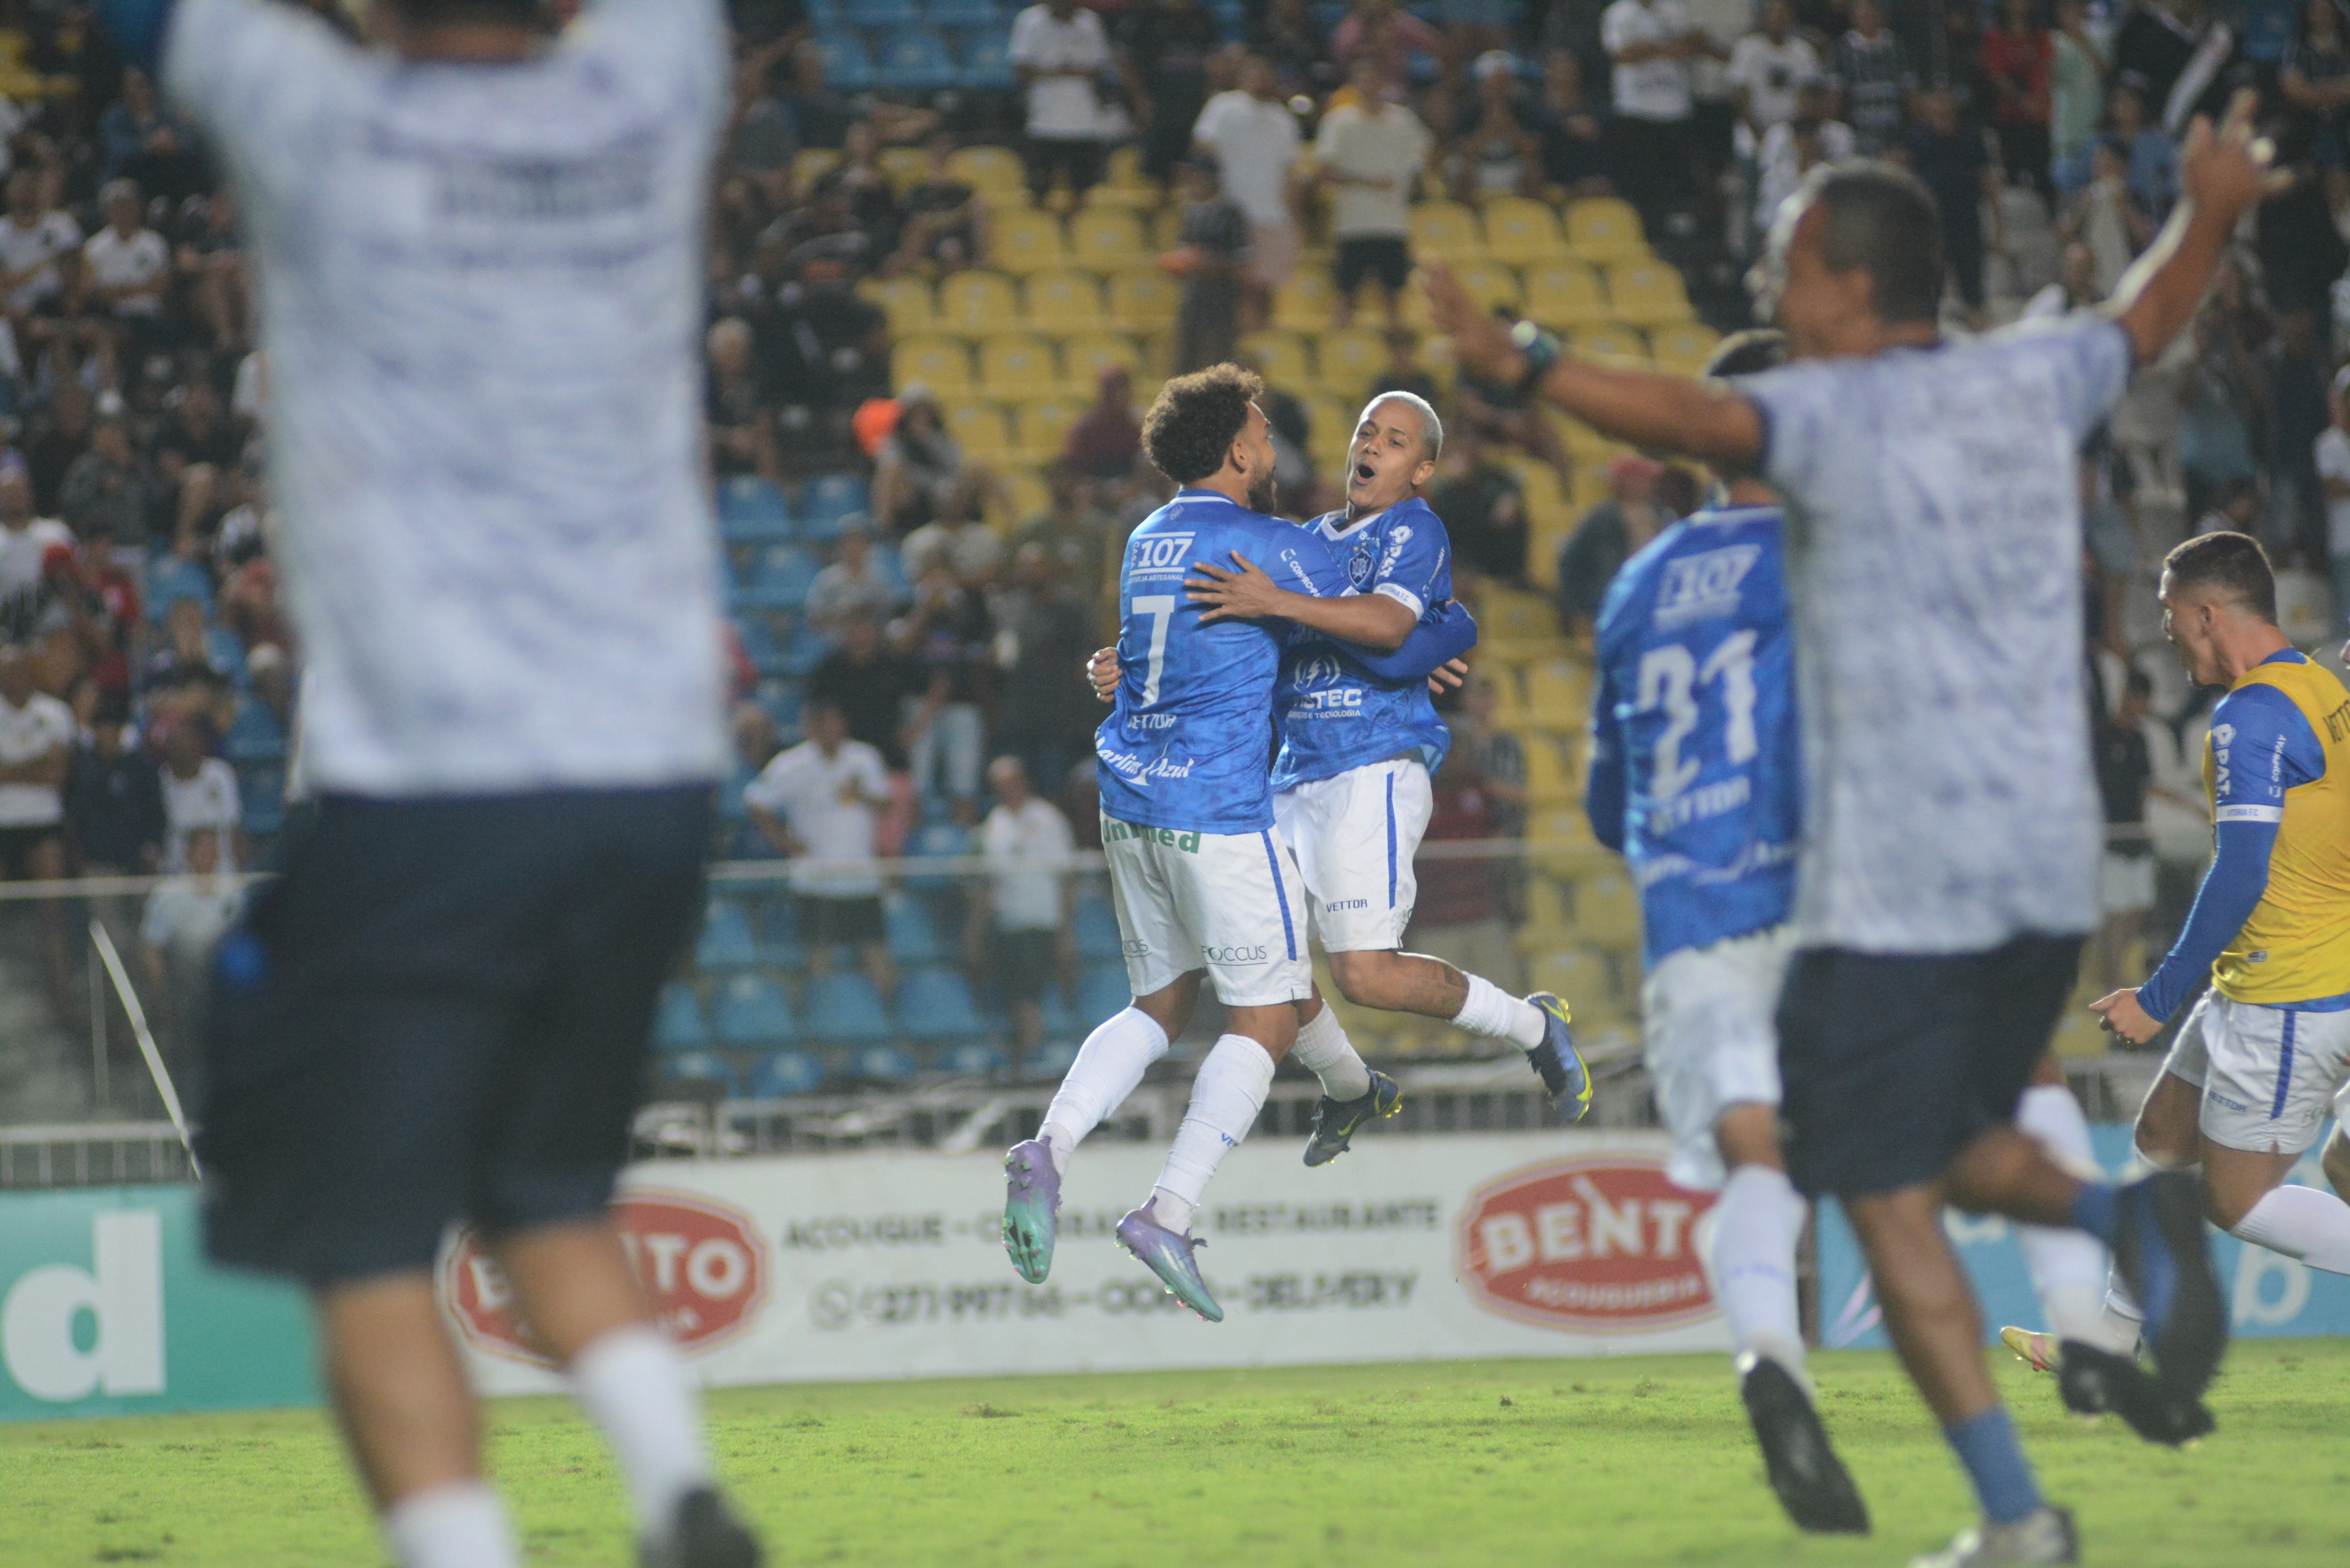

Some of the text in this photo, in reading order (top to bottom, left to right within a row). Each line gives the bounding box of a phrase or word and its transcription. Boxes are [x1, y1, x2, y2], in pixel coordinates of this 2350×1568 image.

[1130, 541, 1141, 569] CASA
[1137, 538, 1193, 568] 107
[1132, 595, 1176, 709] 7
[1315, 709, 1361, 719] TECNOLOGIA
[1636, 629, 1759, 802] 21
[1149, 758, 1194, 778] Azul
[1326, 898, 1368, 913] VETTOR
